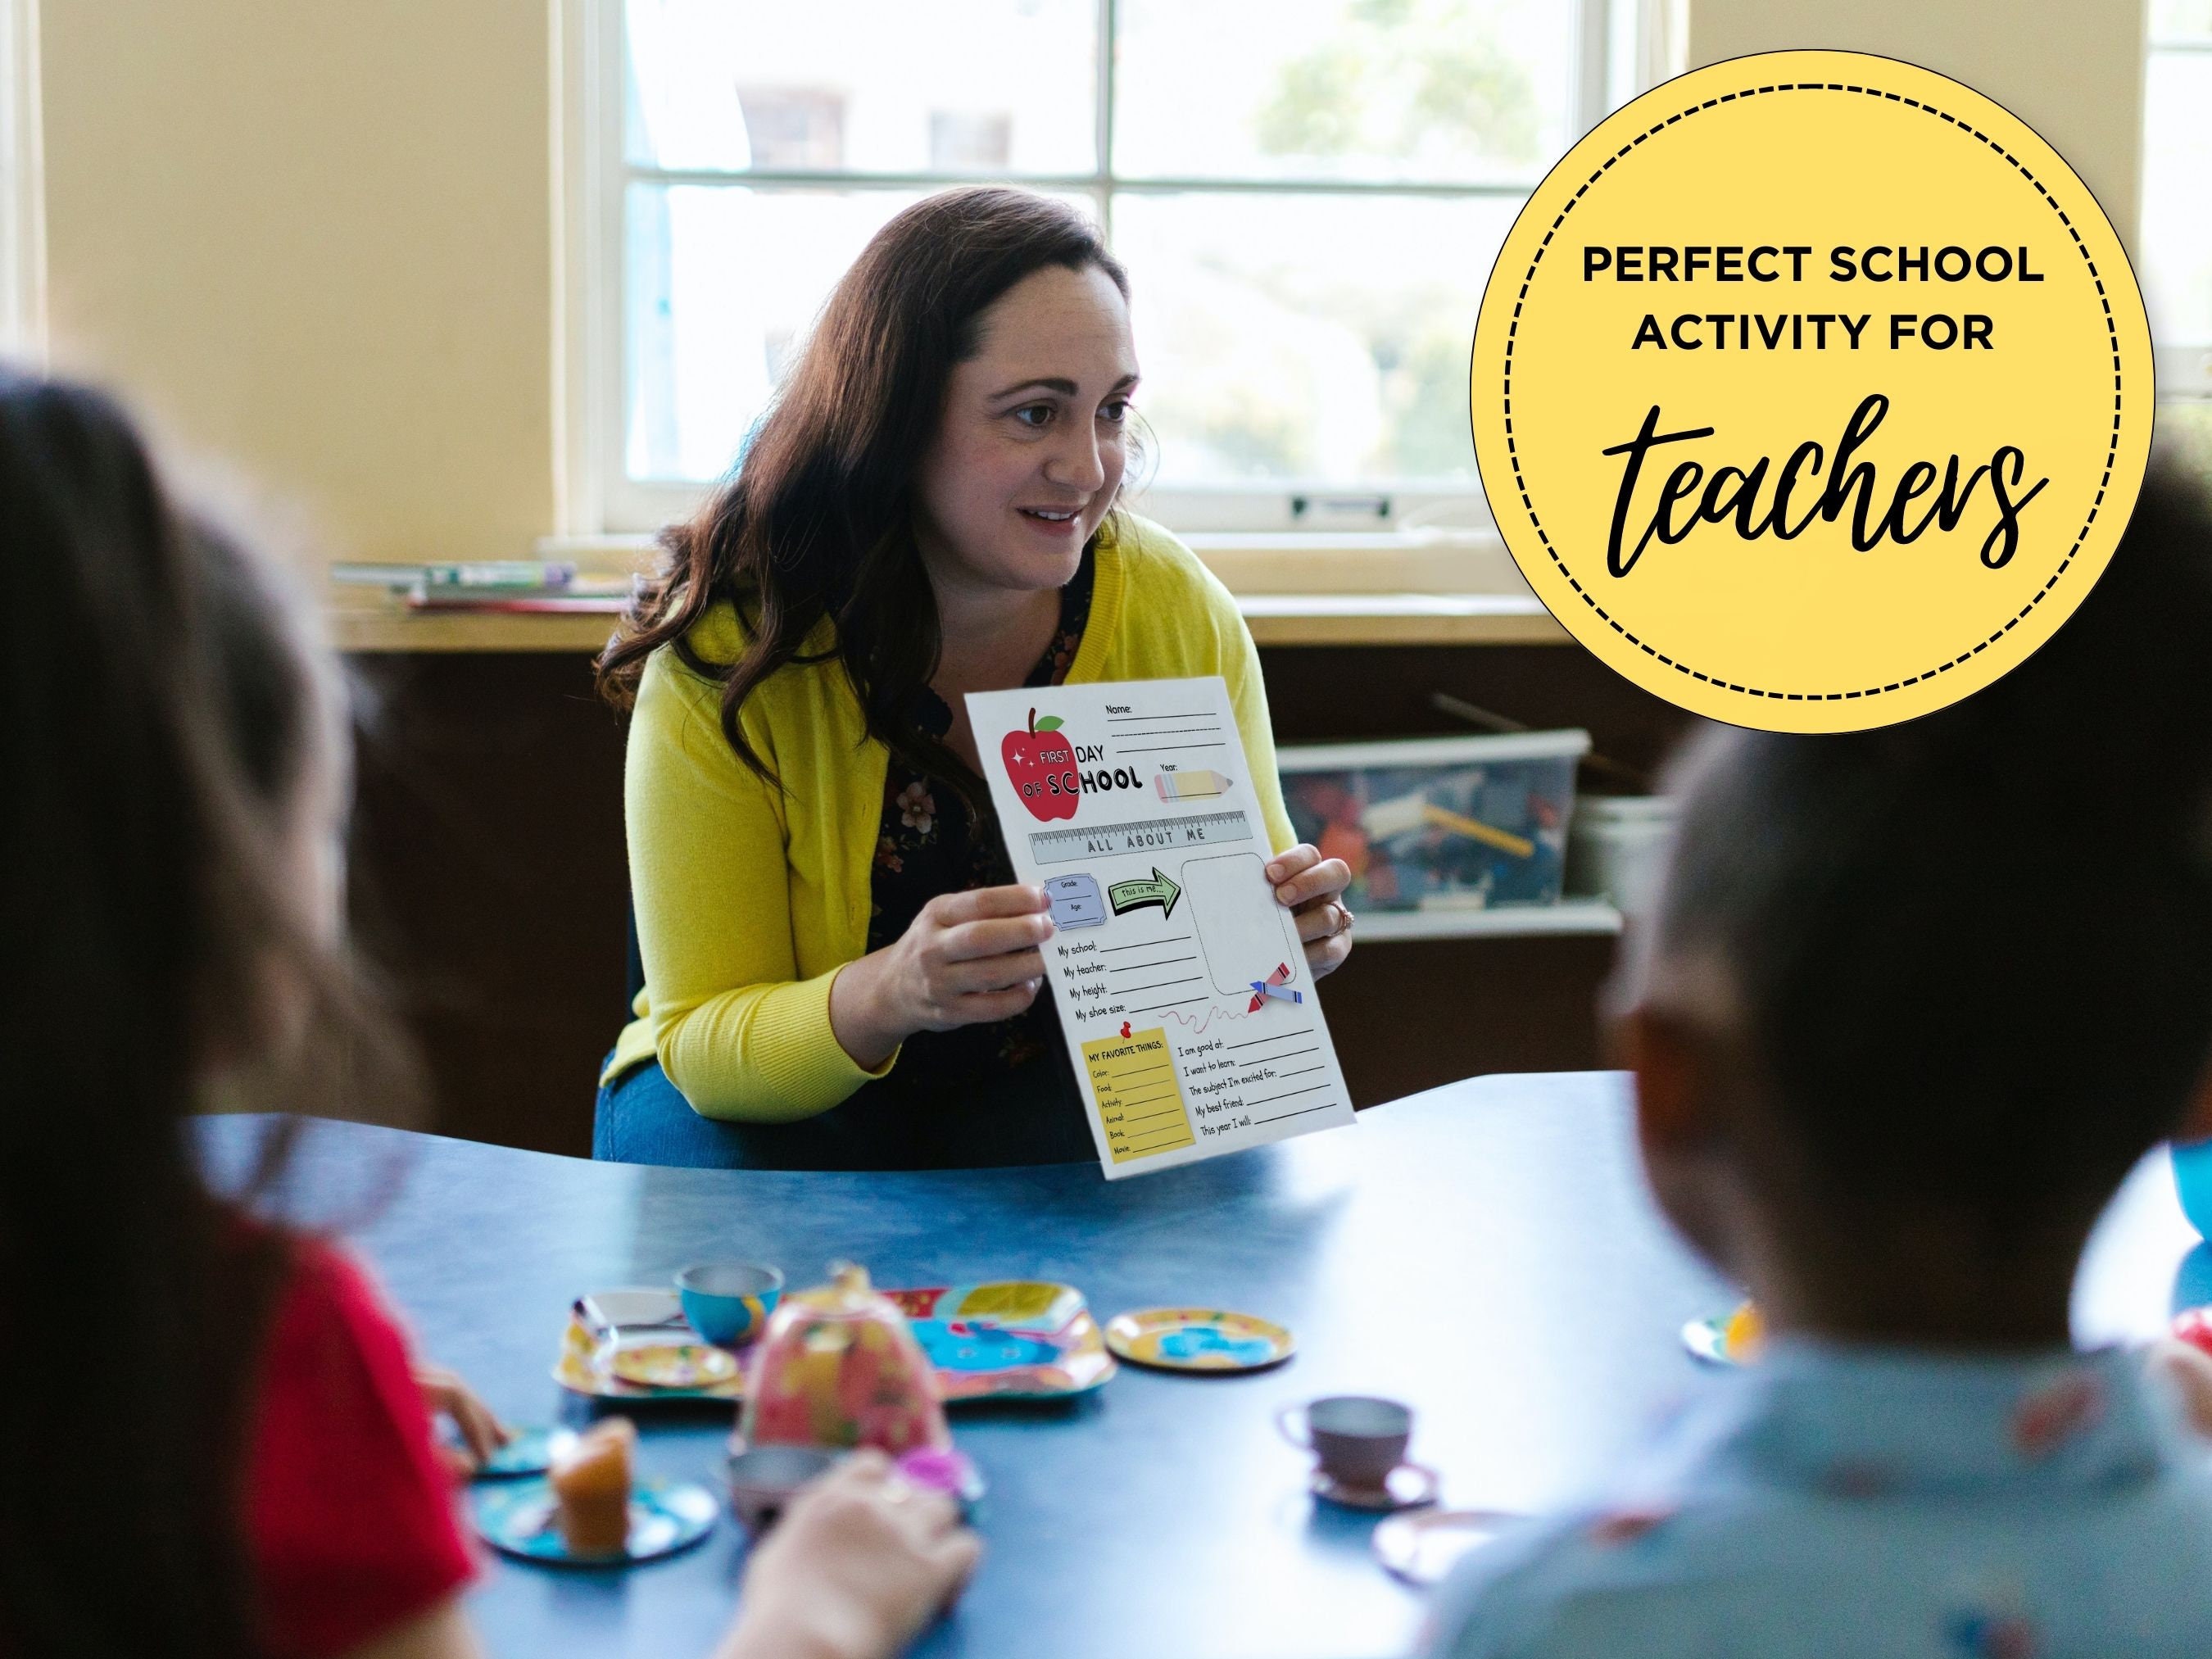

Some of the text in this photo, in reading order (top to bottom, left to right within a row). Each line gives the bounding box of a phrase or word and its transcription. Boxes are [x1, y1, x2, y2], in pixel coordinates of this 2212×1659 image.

[1106, 705, 1132, 714] Name:
[1040, 745, 1104, 764] FIRST DAY
[1160, 764, 1177, 772] Year:
[1023, 765, 1143, 798] OF SCHOOL
[1088, 828, 1204, 852] ALL ABOUT ME
[1122, 888, 1135, 896] this
[1058, 941, 1097, 958] My school:
[1063, 963, 1107, 979] My teacher:
[1070, 984, 1107, 1000] My height:
[1076, 1004, 1126, 1022] My shoe size:
[1089, 1040, 1163, 1063] MY FAVORITE THINGS:
[1178, 1038, 1223, 1057] I am good at:
[1093, 1069, 1108, 1078] Color:
[1184, 1059, 1235, 1077] I want to learn:
[1189, 1068, 1276, 1095] The subject I'm excited for:
[1195, 1096, 1244, 1118] My best friend:
[1200, 1116, 1251, 1135] This year I will:
